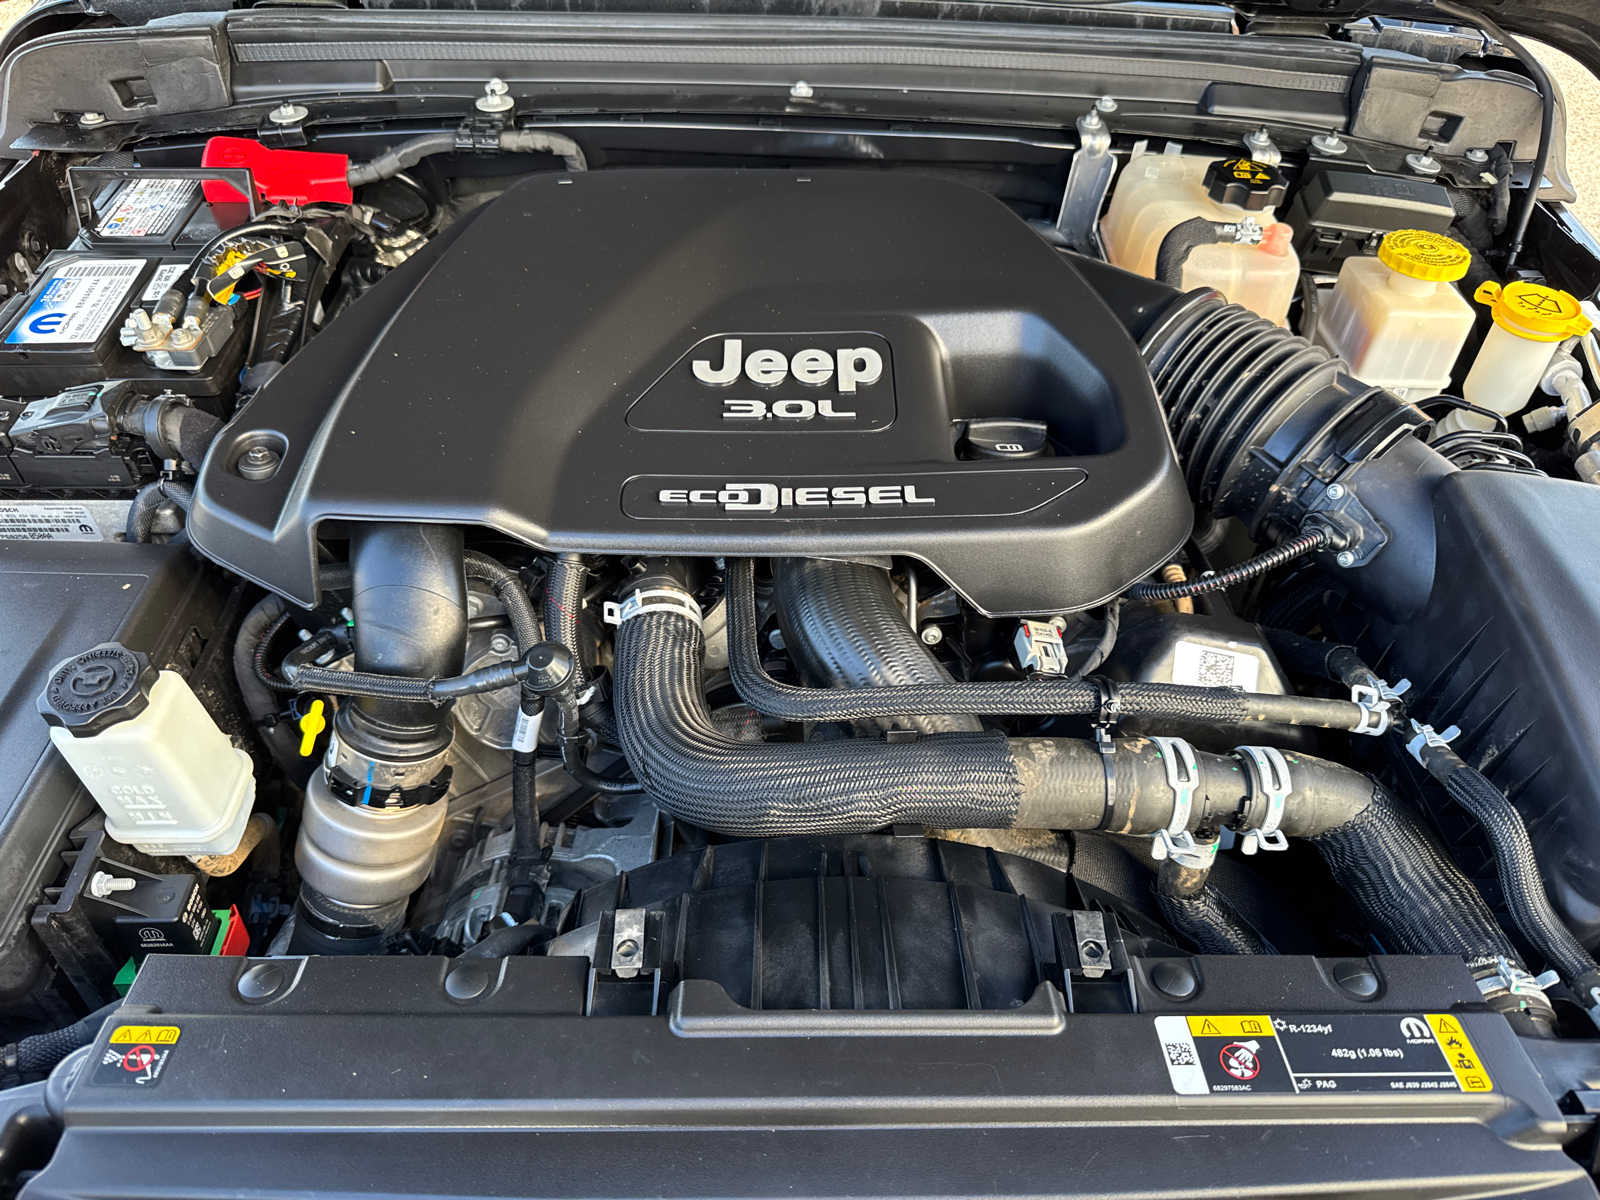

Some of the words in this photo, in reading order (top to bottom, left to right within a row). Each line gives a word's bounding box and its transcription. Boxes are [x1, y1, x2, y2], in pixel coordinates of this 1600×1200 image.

[692, 339, 883, 394] Jeep
[723, 400, 857, 420] 3.0L
[51, 694, 99, 712] APPROVED
[110, 785, 155, 795] COLD
[116, 795, 163, 805] MAX
[128, 811, 174, 821] MIN
[1289, 1024, 1333, 1035] R-1234yf
[1331, 1048, 1357, 1059] 482g
[1357, 1048, 1382, 1059] (1.06
[1382, 1048, 1404, 1060] lbs)
[1315, 1080, 1337, 1089] PAG
